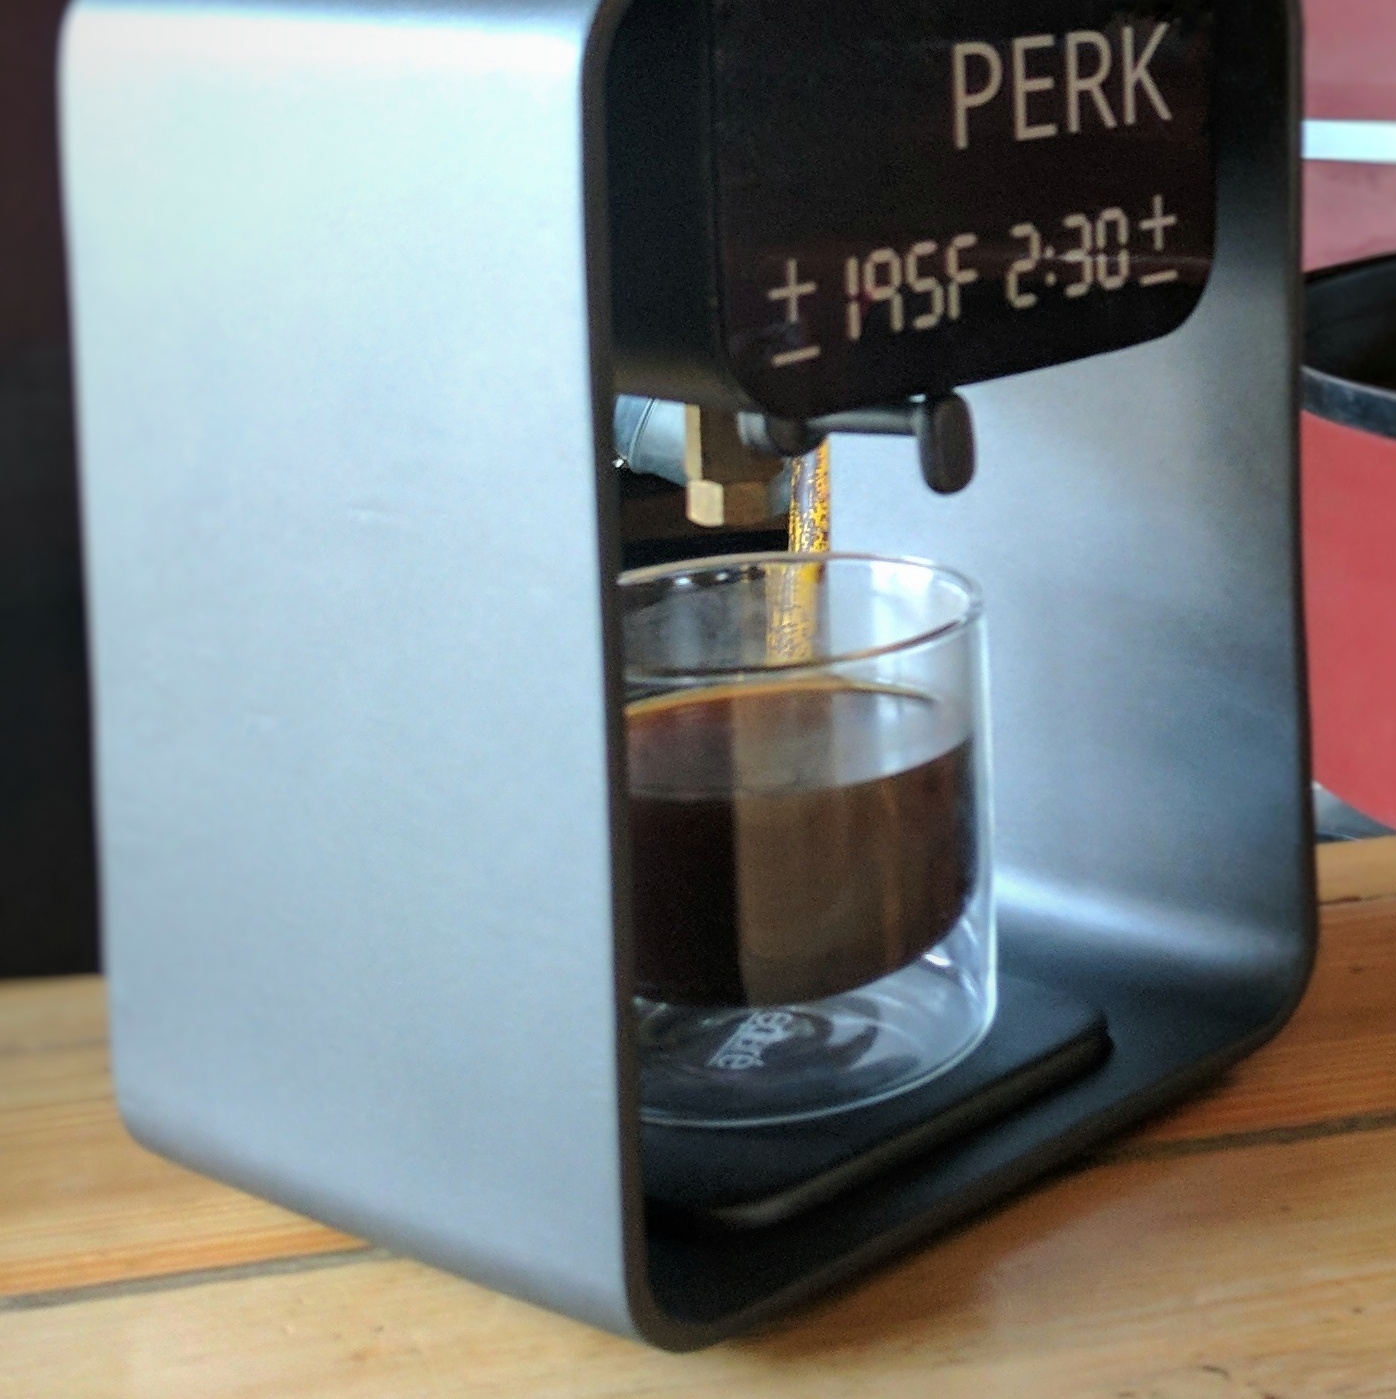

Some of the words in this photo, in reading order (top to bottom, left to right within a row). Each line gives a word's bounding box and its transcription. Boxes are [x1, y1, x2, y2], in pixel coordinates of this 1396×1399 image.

[951, 23, 1171, 149] PERK
[844, 233, 978, 341] 195F
[1006, 207, 1129, 309] 2:30
